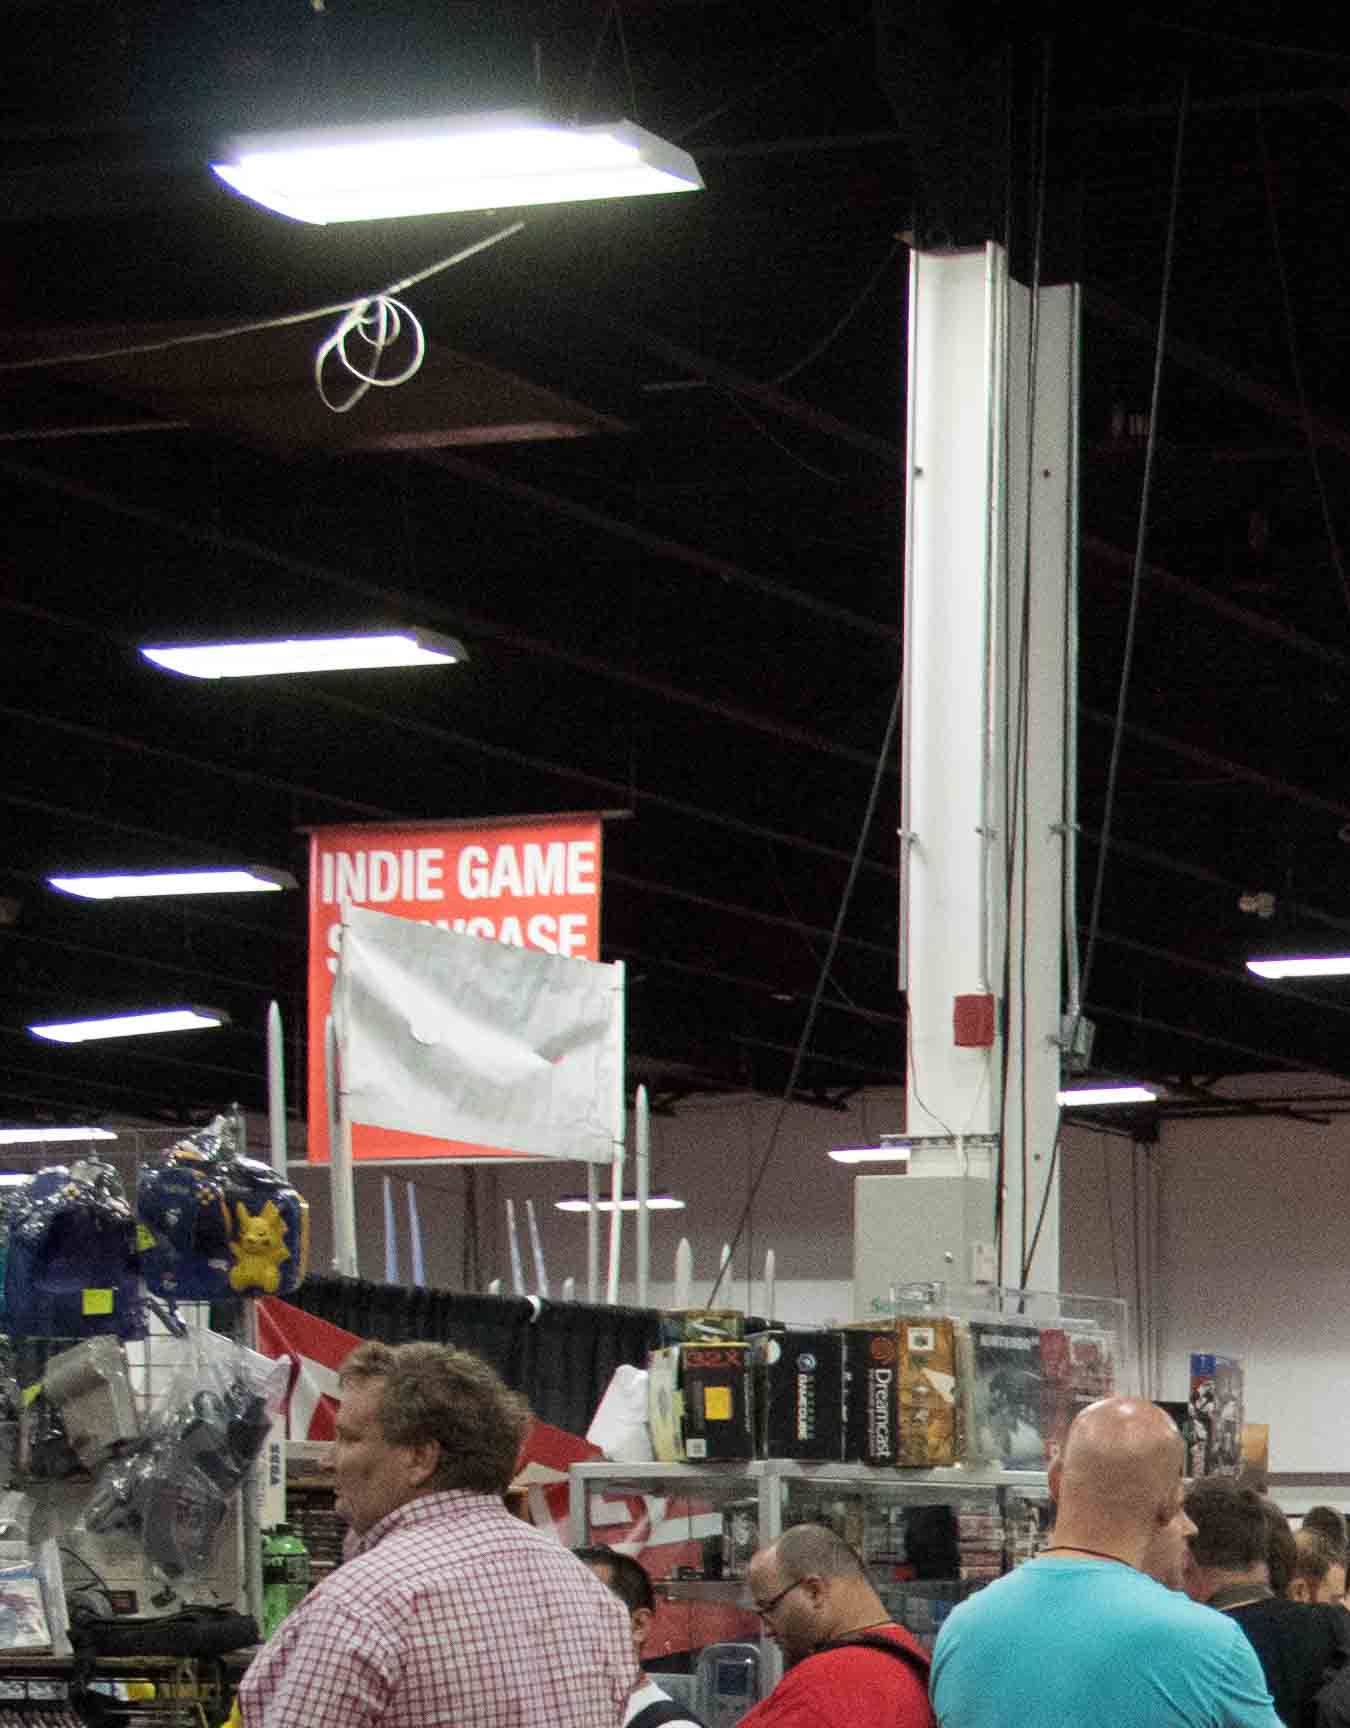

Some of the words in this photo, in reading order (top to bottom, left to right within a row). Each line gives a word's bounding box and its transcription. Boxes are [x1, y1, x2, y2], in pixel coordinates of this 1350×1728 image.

[321, 847, 444, 904] INDIE
[457, 840, 596, 900] GAME
[874, 1367, 893, 1458] Dreamcast
